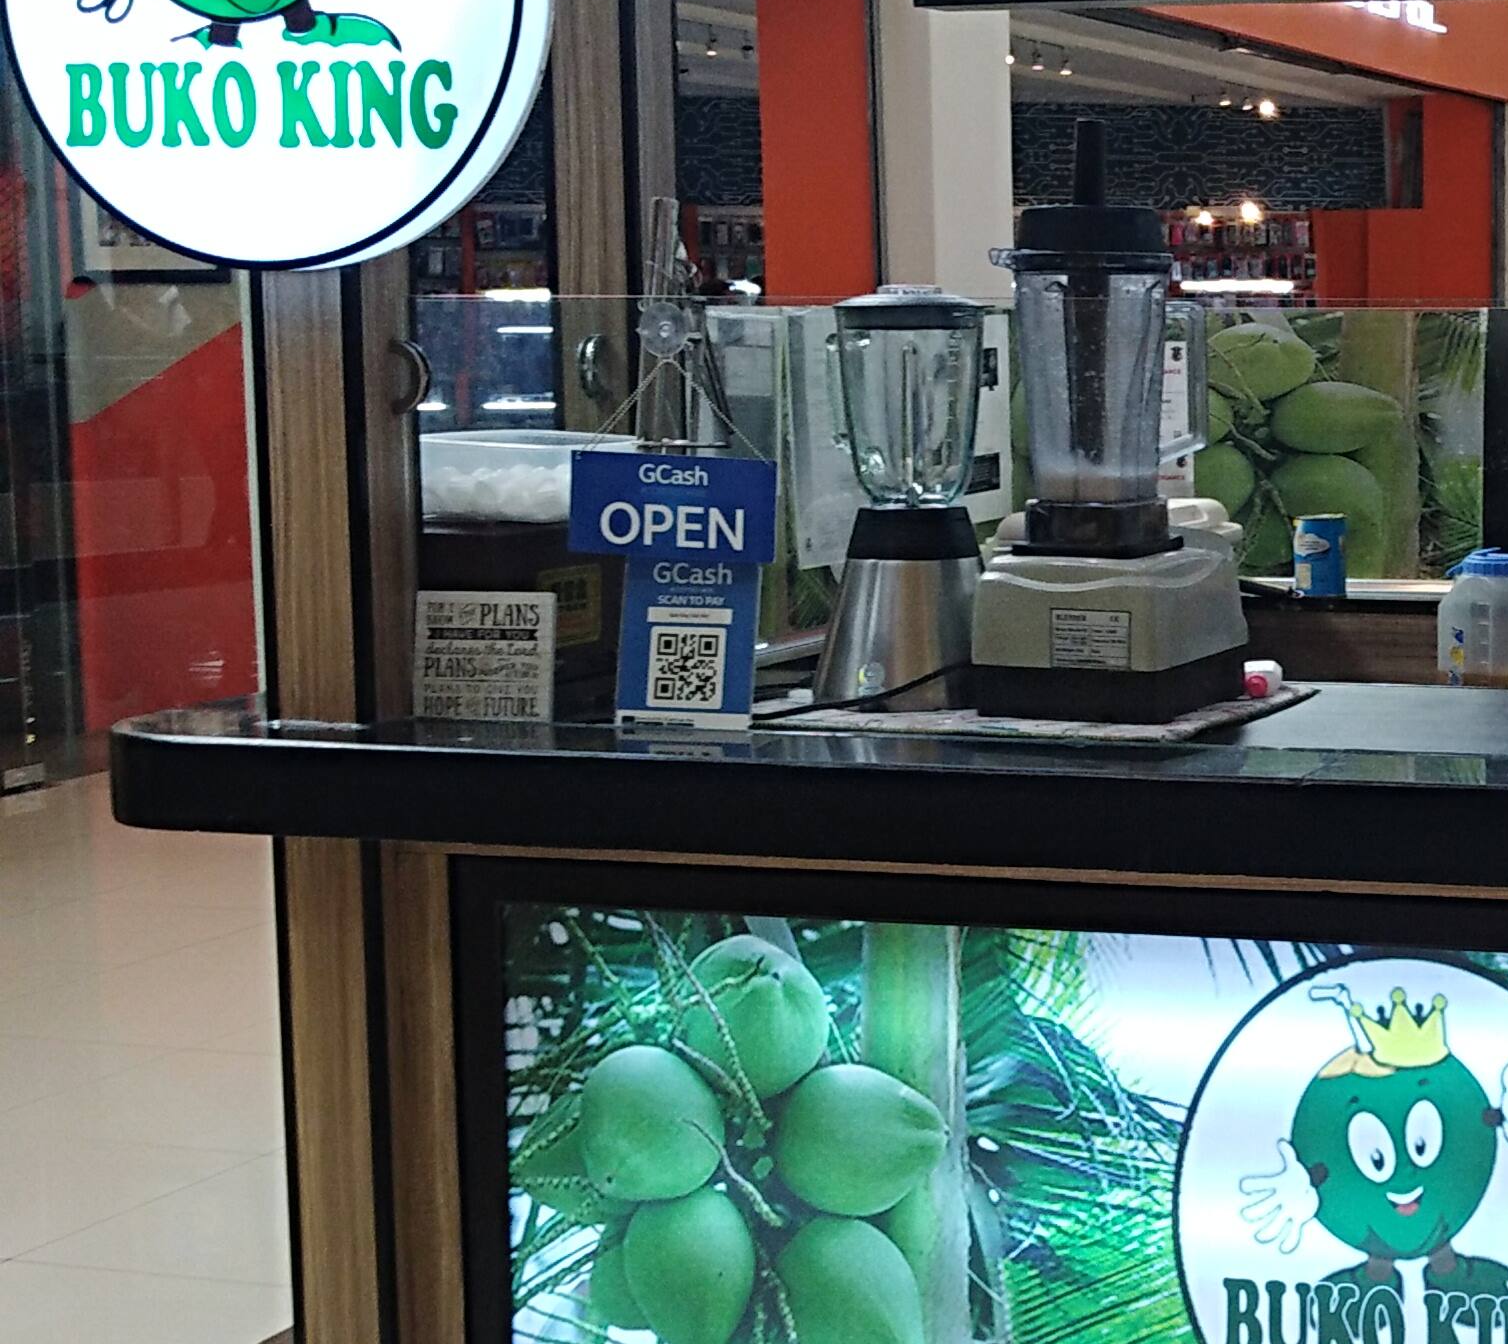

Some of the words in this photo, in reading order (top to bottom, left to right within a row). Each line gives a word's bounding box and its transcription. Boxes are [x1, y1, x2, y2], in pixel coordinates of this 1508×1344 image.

[65, 61, 257, 148] BUKO
[276, 59, 459, 150] KING
[639, 464, 709, 486] GCash
[600, 501, 744, 551] OPEN
[653, 562, 732, 585] GCash
[658, 595, 688, 604] SCAN
[690, 596, 704, 604] TO
[705, 597, 725, 605] PAY
[480, 603, 540, 626] PLANS
[424, 657, 477, 677] PLANS
[484, 697, 539, 717] FUTURE
